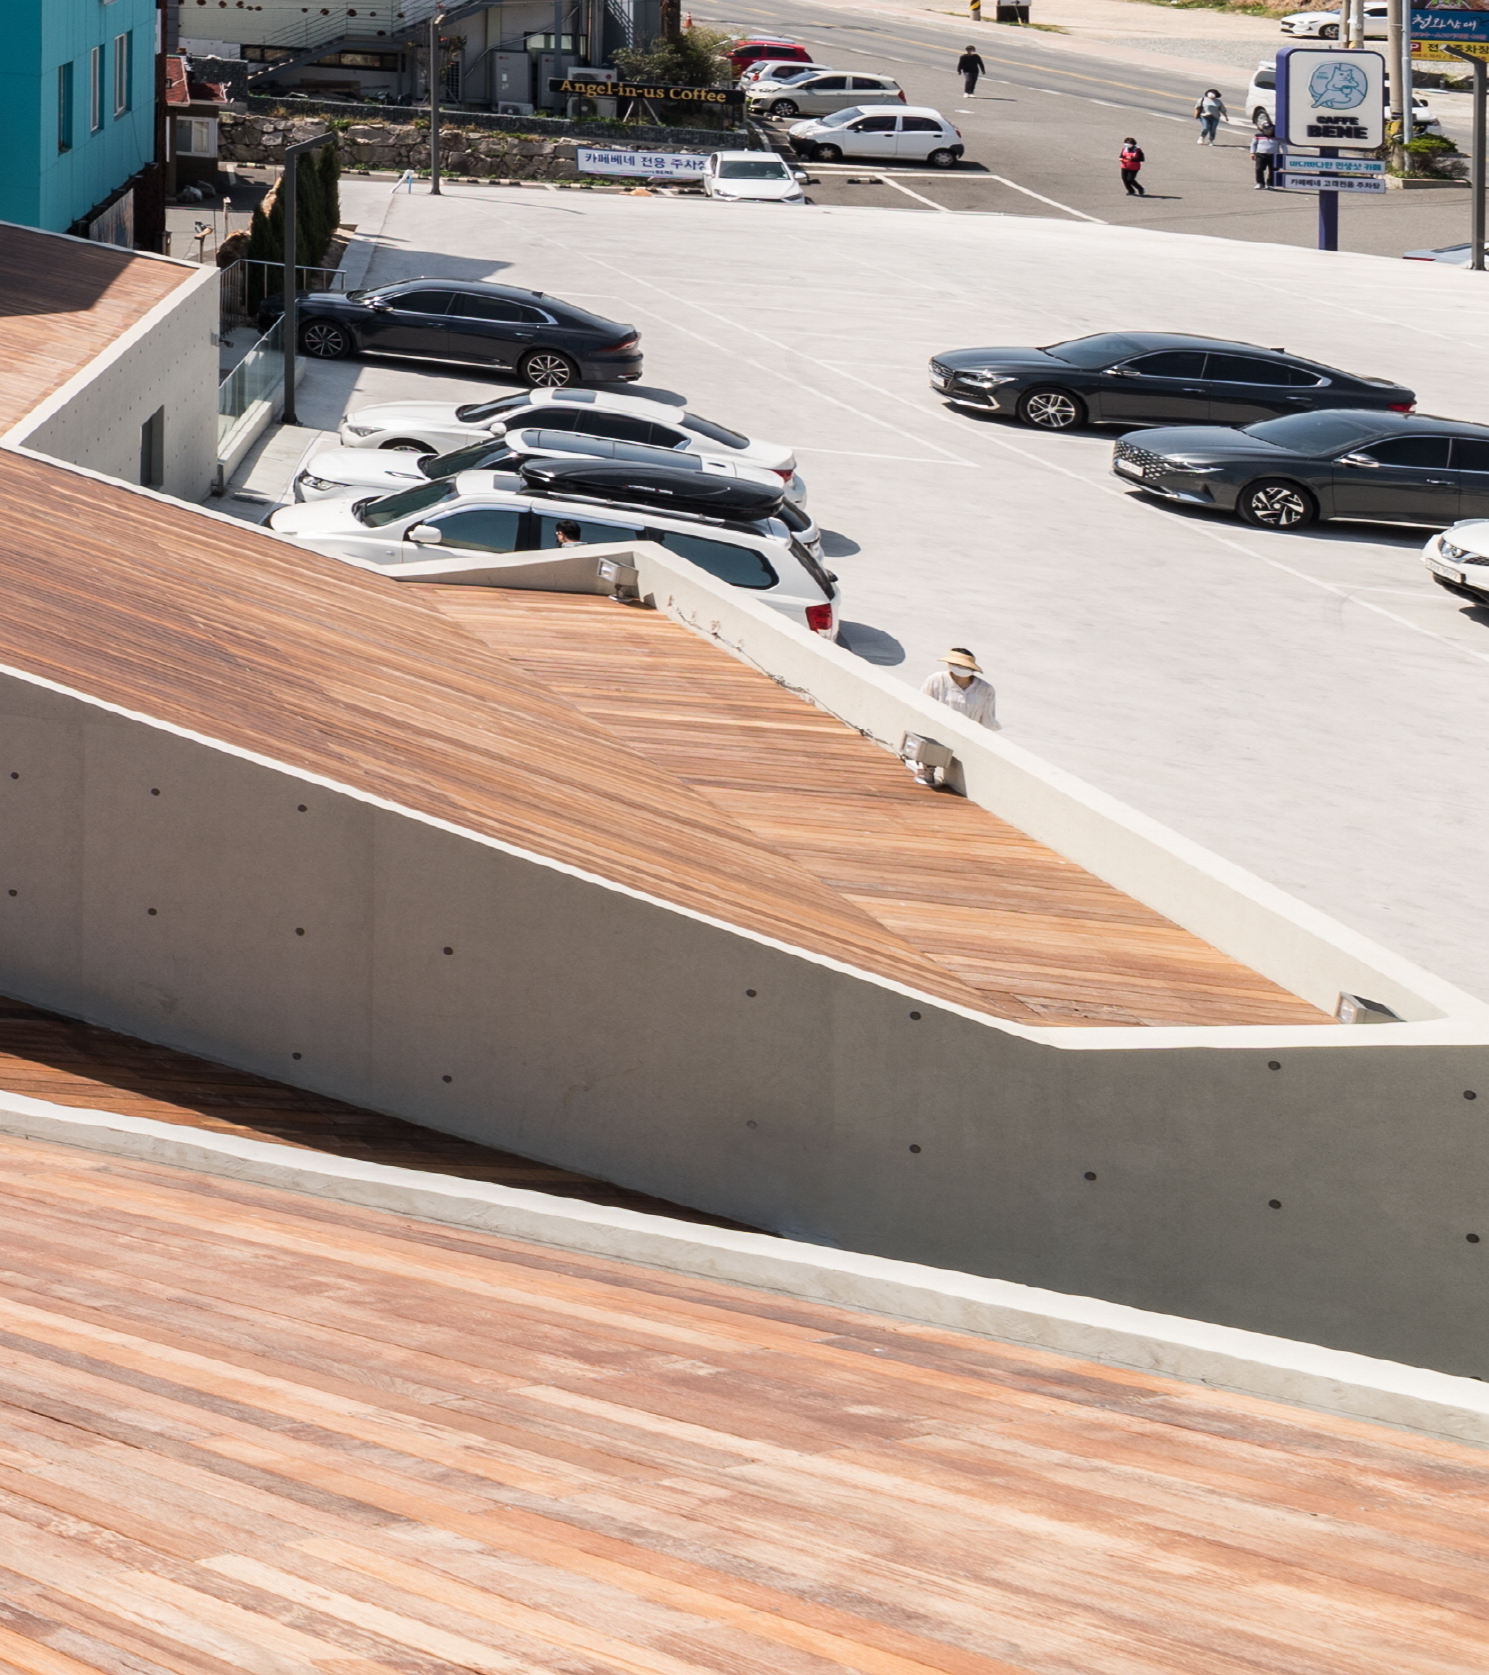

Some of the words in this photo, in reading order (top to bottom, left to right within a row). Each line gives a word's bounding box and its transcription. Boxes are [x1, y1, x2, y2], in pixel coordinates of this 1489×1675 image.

[559, 80, 664, 98] Angel-in-us
[670, 87, 727, 103] Coffee
[1316, 116, 1359, 125] CAFFE
[1307, 125, 1368, 139] BENE
[585, 152, 636, 167] 카페베네
[641, 156, 665, 168] 전용
